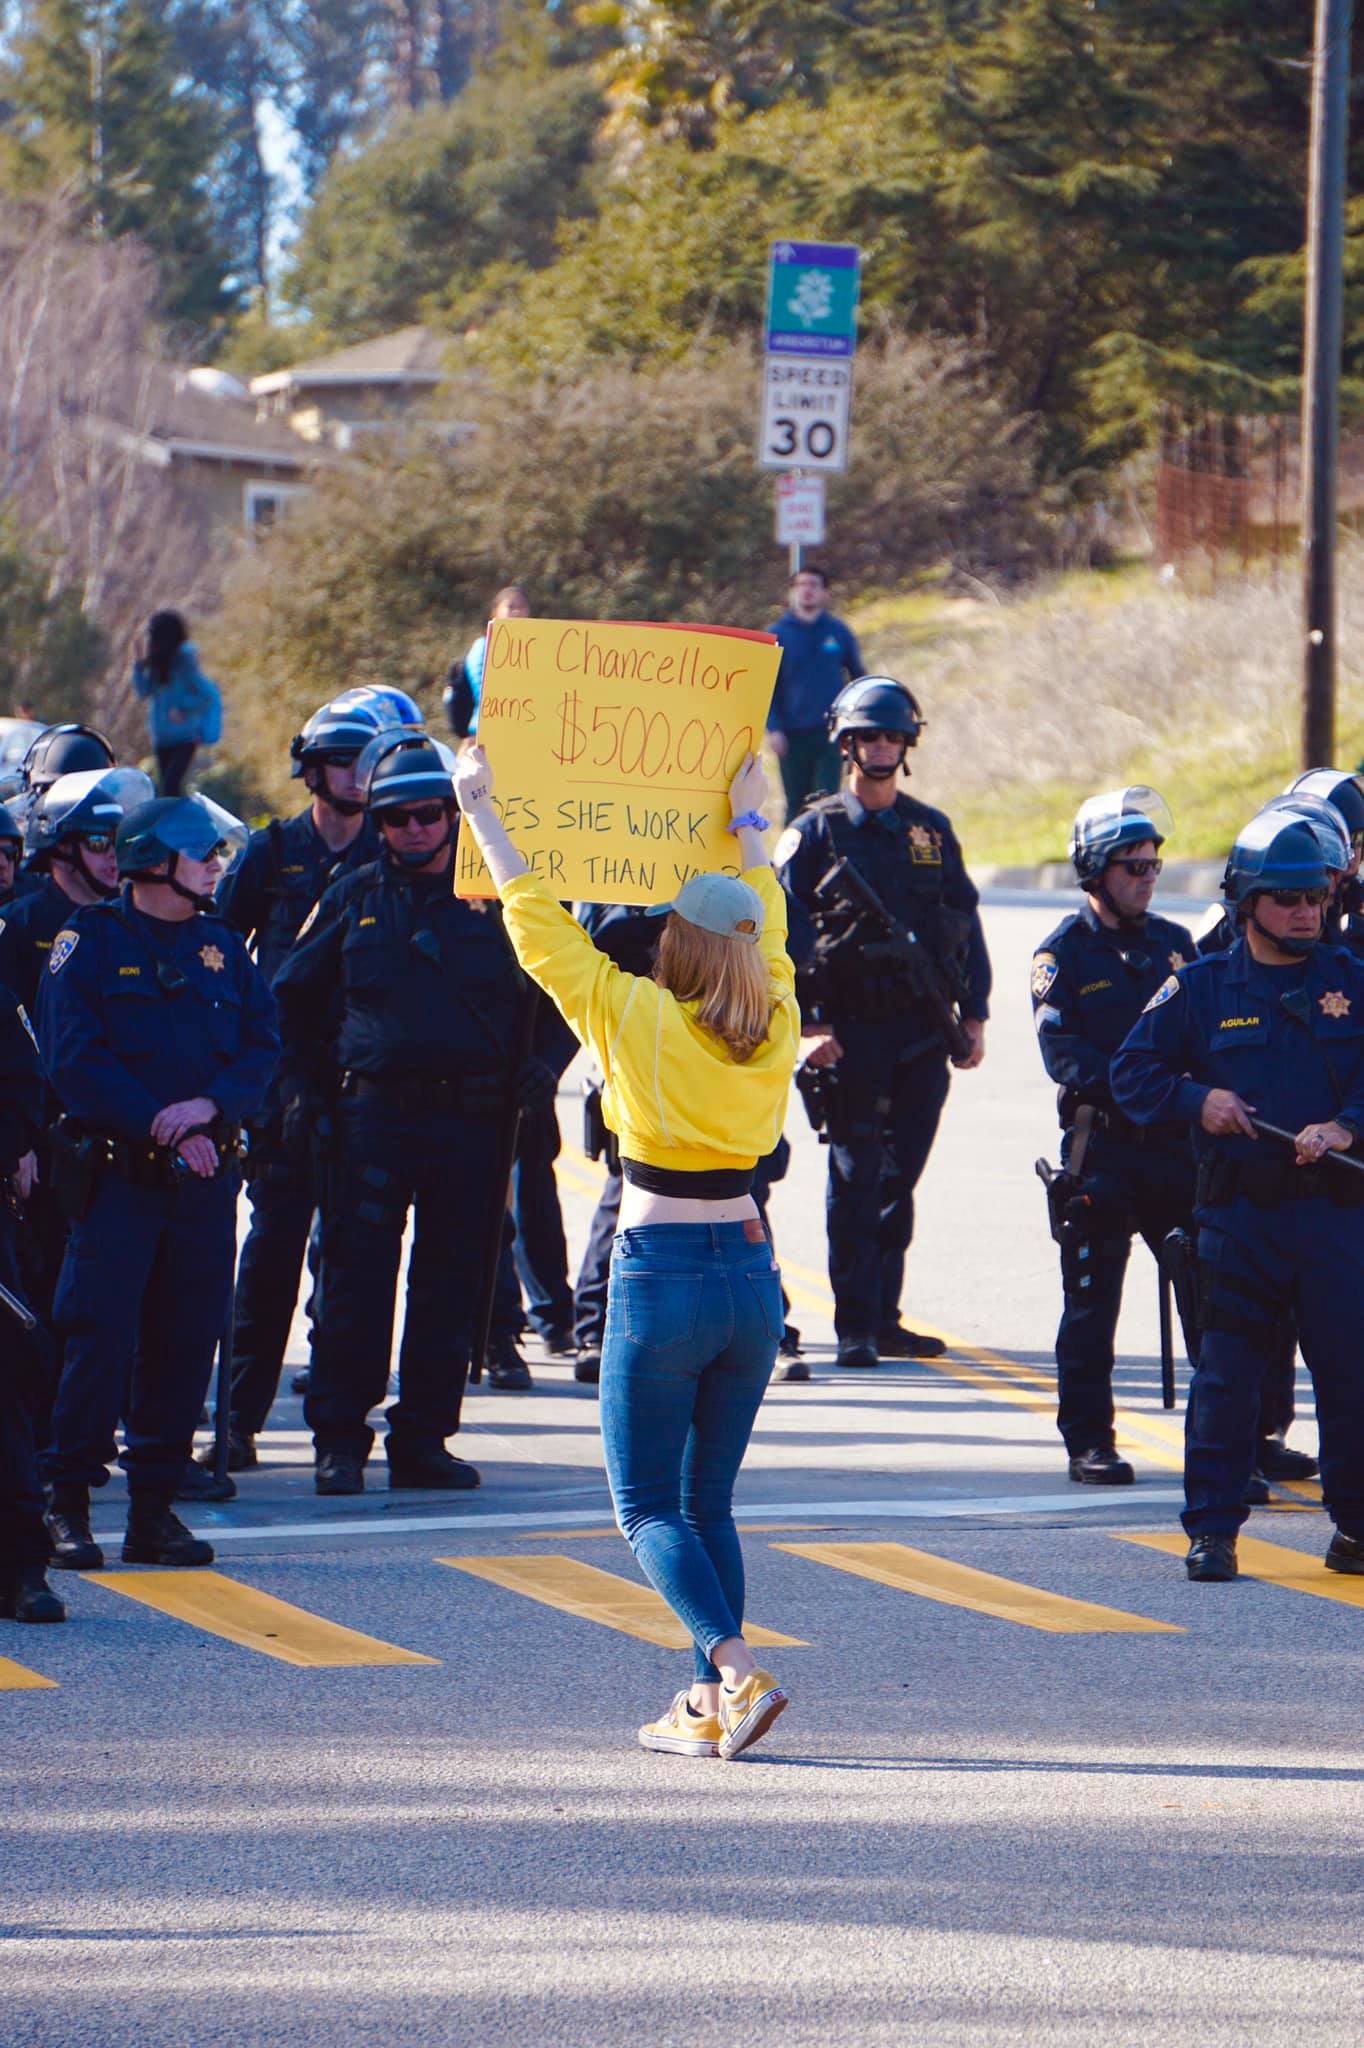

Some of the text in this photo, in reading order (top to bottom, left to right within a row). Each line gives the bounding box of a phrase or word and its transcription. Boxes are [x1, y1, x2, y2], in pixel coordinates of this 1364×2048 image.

[772, 366, 847, 385] SPEED
[773, 392, 836, 412] LIMIT
[771, 419, 835, 458] 30
[491, 623, 749, 692] Our Chancellor
[481, 695, 536, 722] earns
[557, 800, 615, 832] SHE
[627, 804, 709, 849] WORK
[461, 846, 567, 883] HAER
[584, 856, 656, 890] THAN
[1220, 1016, 1260, 1029] AGUILAR
